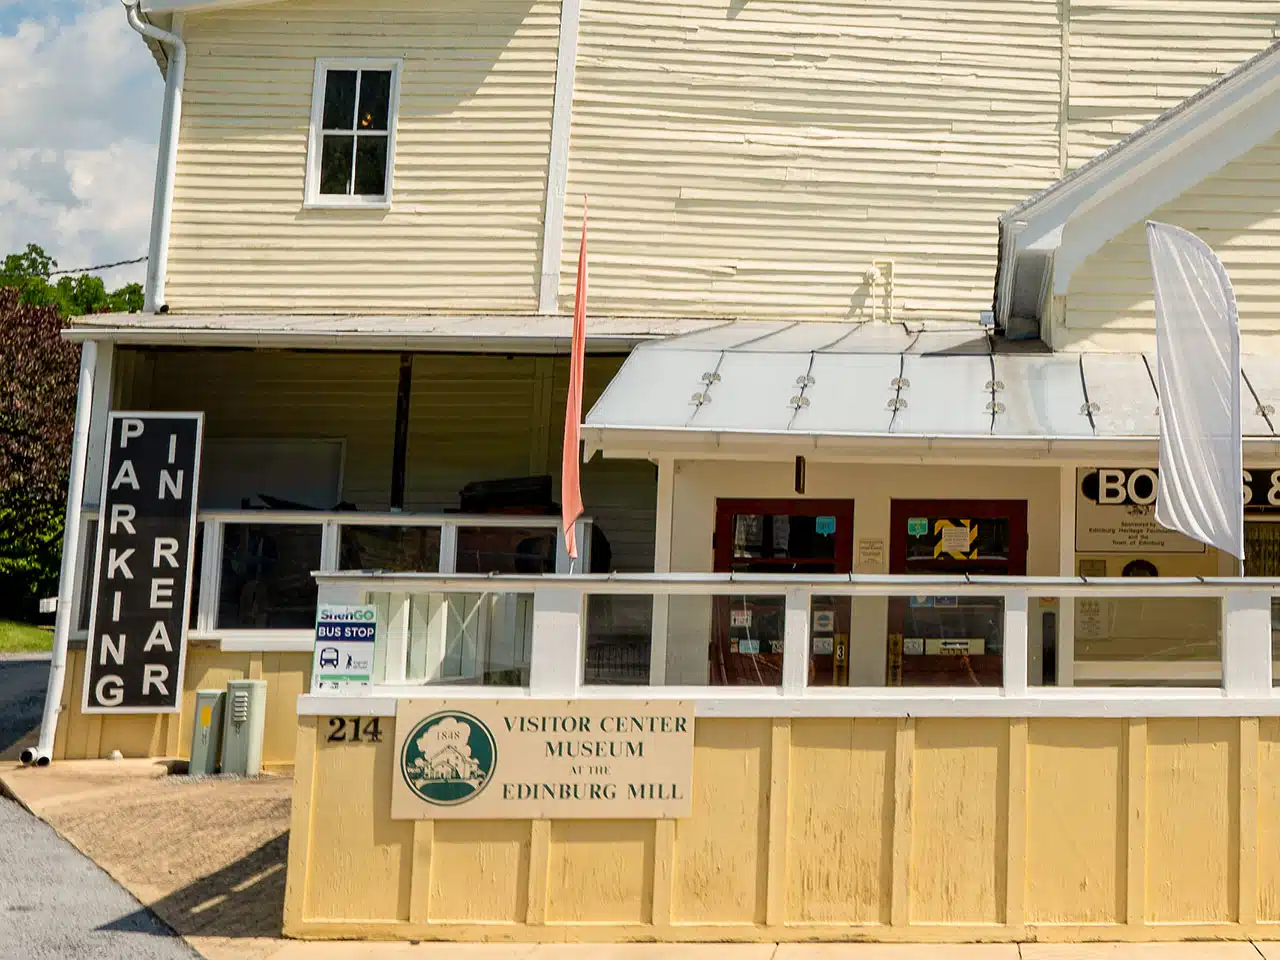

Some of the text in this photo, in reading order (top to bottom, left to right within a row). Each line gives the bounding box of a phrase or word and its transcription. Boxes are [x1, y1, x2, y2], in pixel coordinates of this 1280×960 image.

[95, 418, 145, 707] PARKING
[142, 433, 184, 696] IN REAR
[318, 626, 374, 638] BUS STOP
[327, 716, 383, 743] 214
[503, 716, 687, 733] VISITOR CENTER
[436, 730, 460, 740] 1848
[545, 741, 644, 758] MUSEUM
[569, 765, 611, 775] AT THE
[501, 783, 683, 801] EDINBURG MILL
